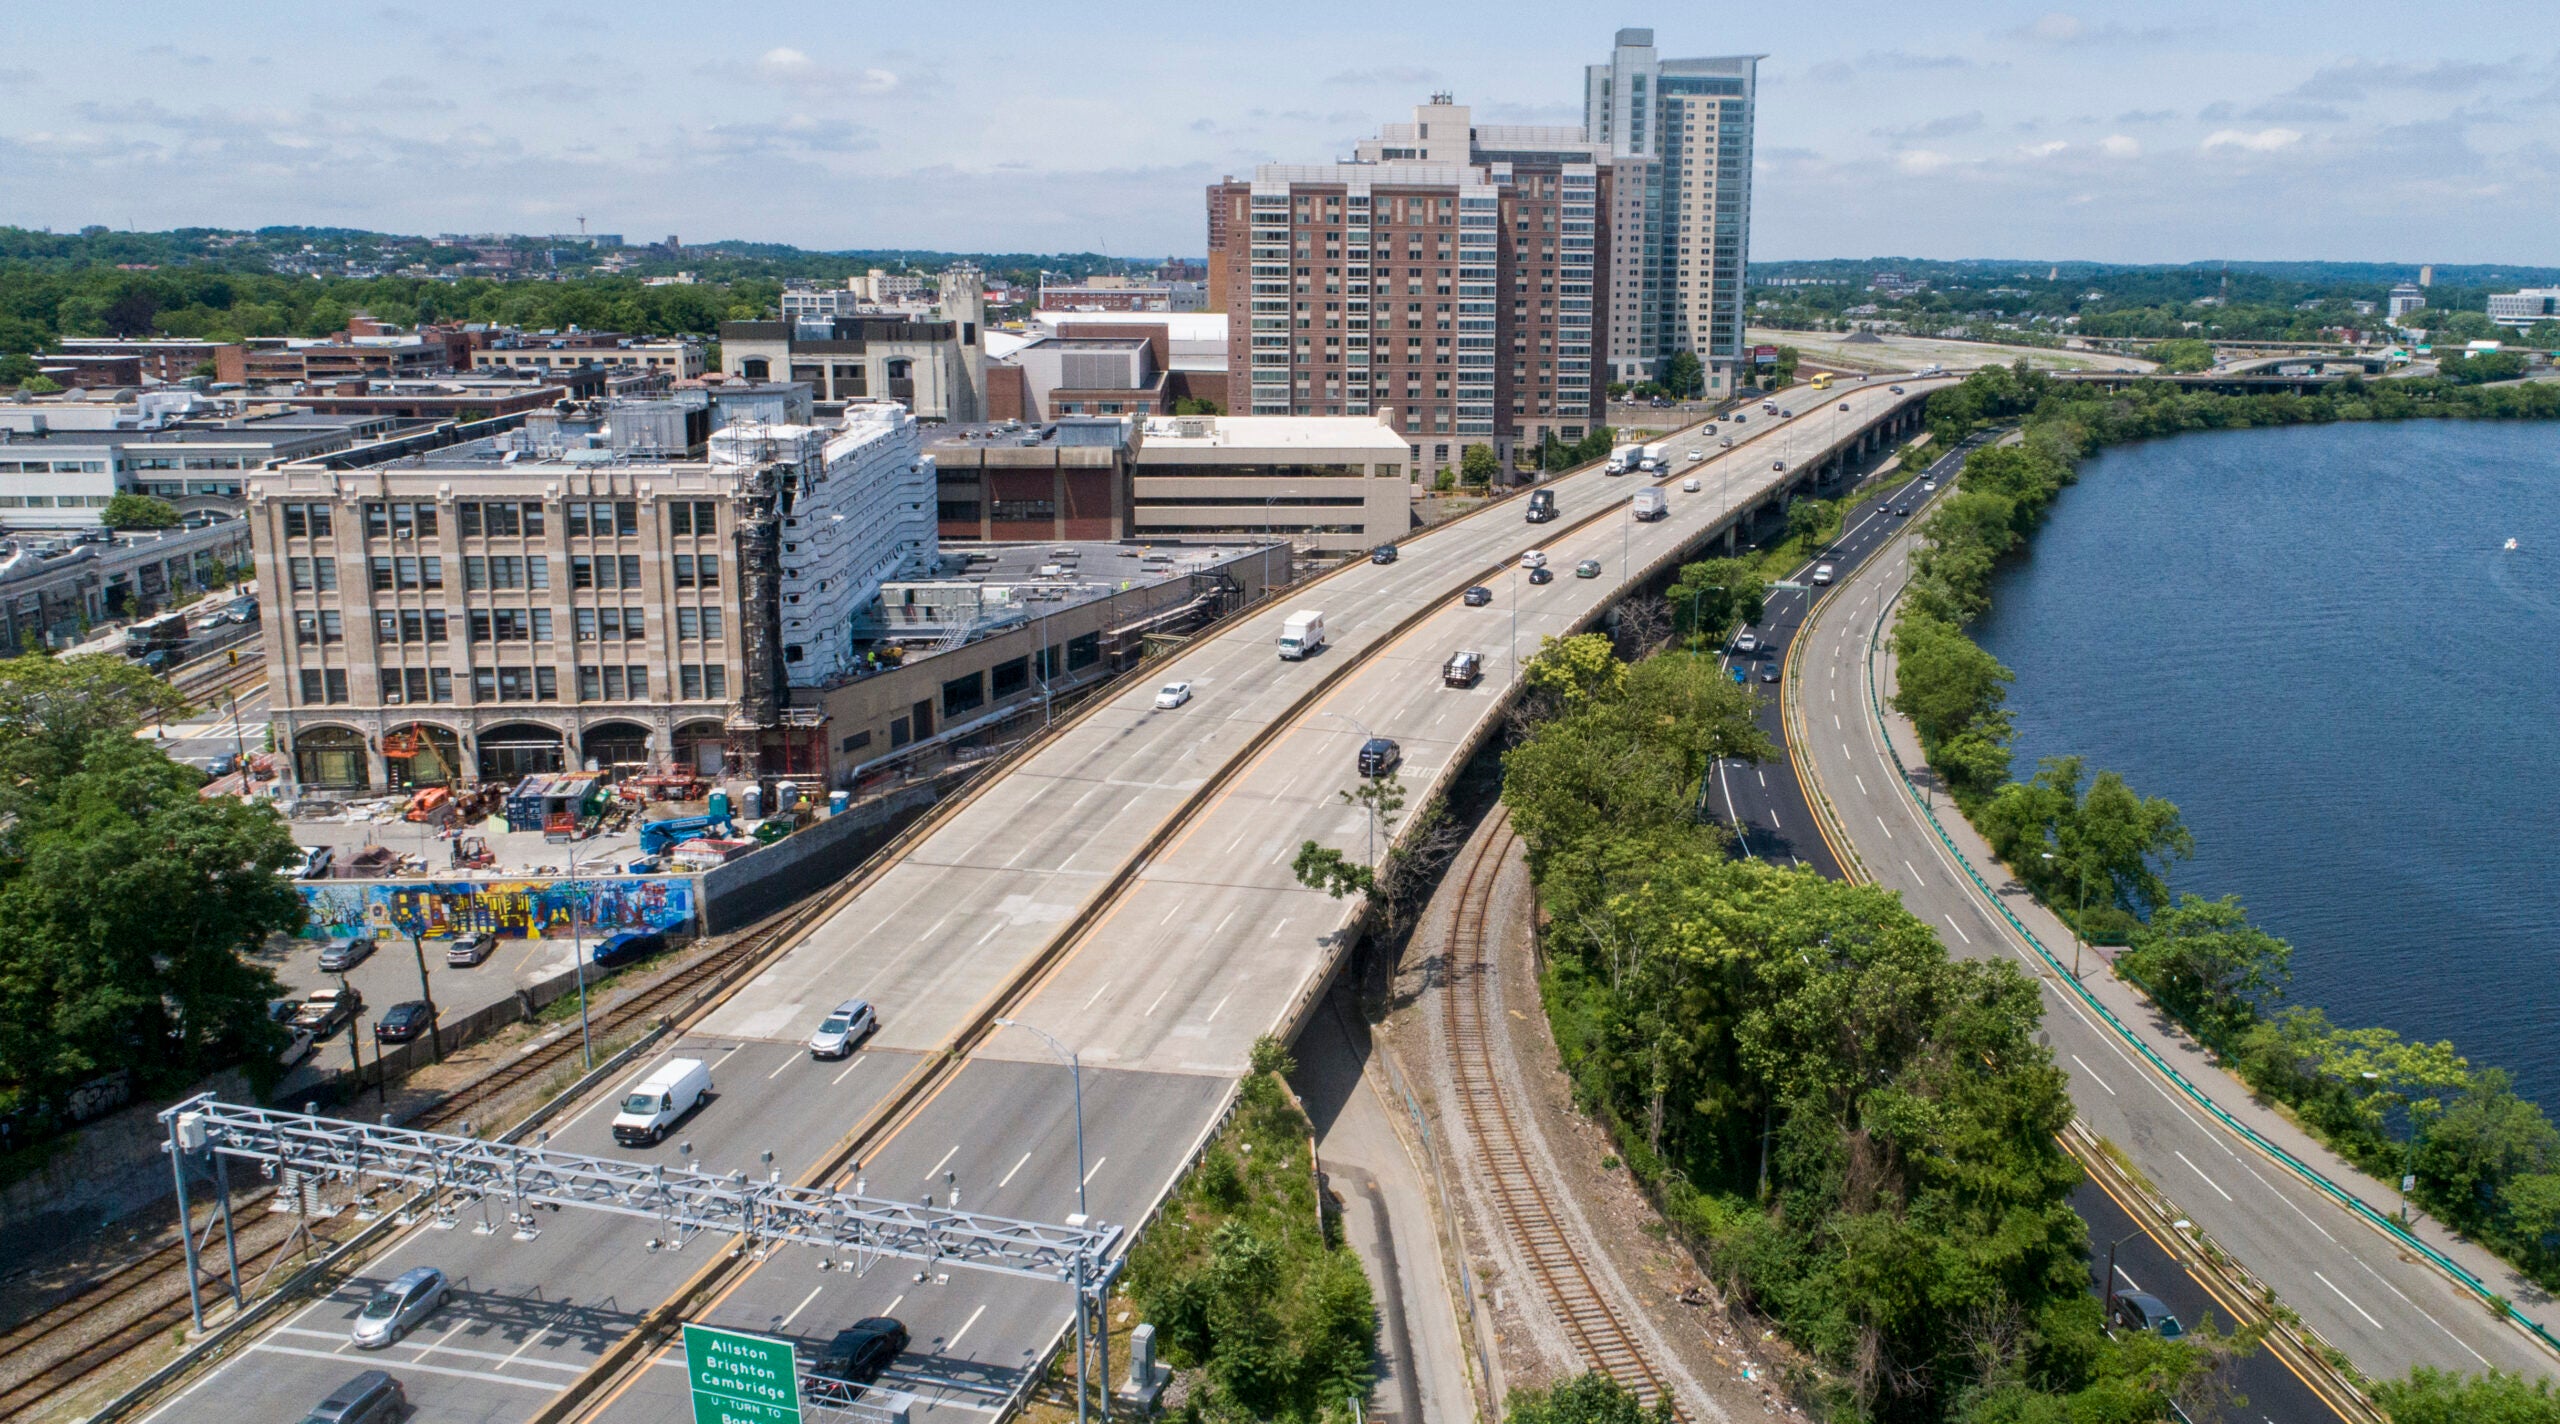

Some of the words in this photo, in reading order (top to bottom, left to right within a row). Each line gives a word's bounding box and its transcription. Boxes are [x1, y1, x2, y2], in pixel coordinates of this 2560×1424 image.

[711, 1340, 768, 1360] Allston
[706, 1356, 775, 1379] Brighton
[701, 1372, 785, 1400] Cambridge
[766, 1407, 781, 1418] TO
